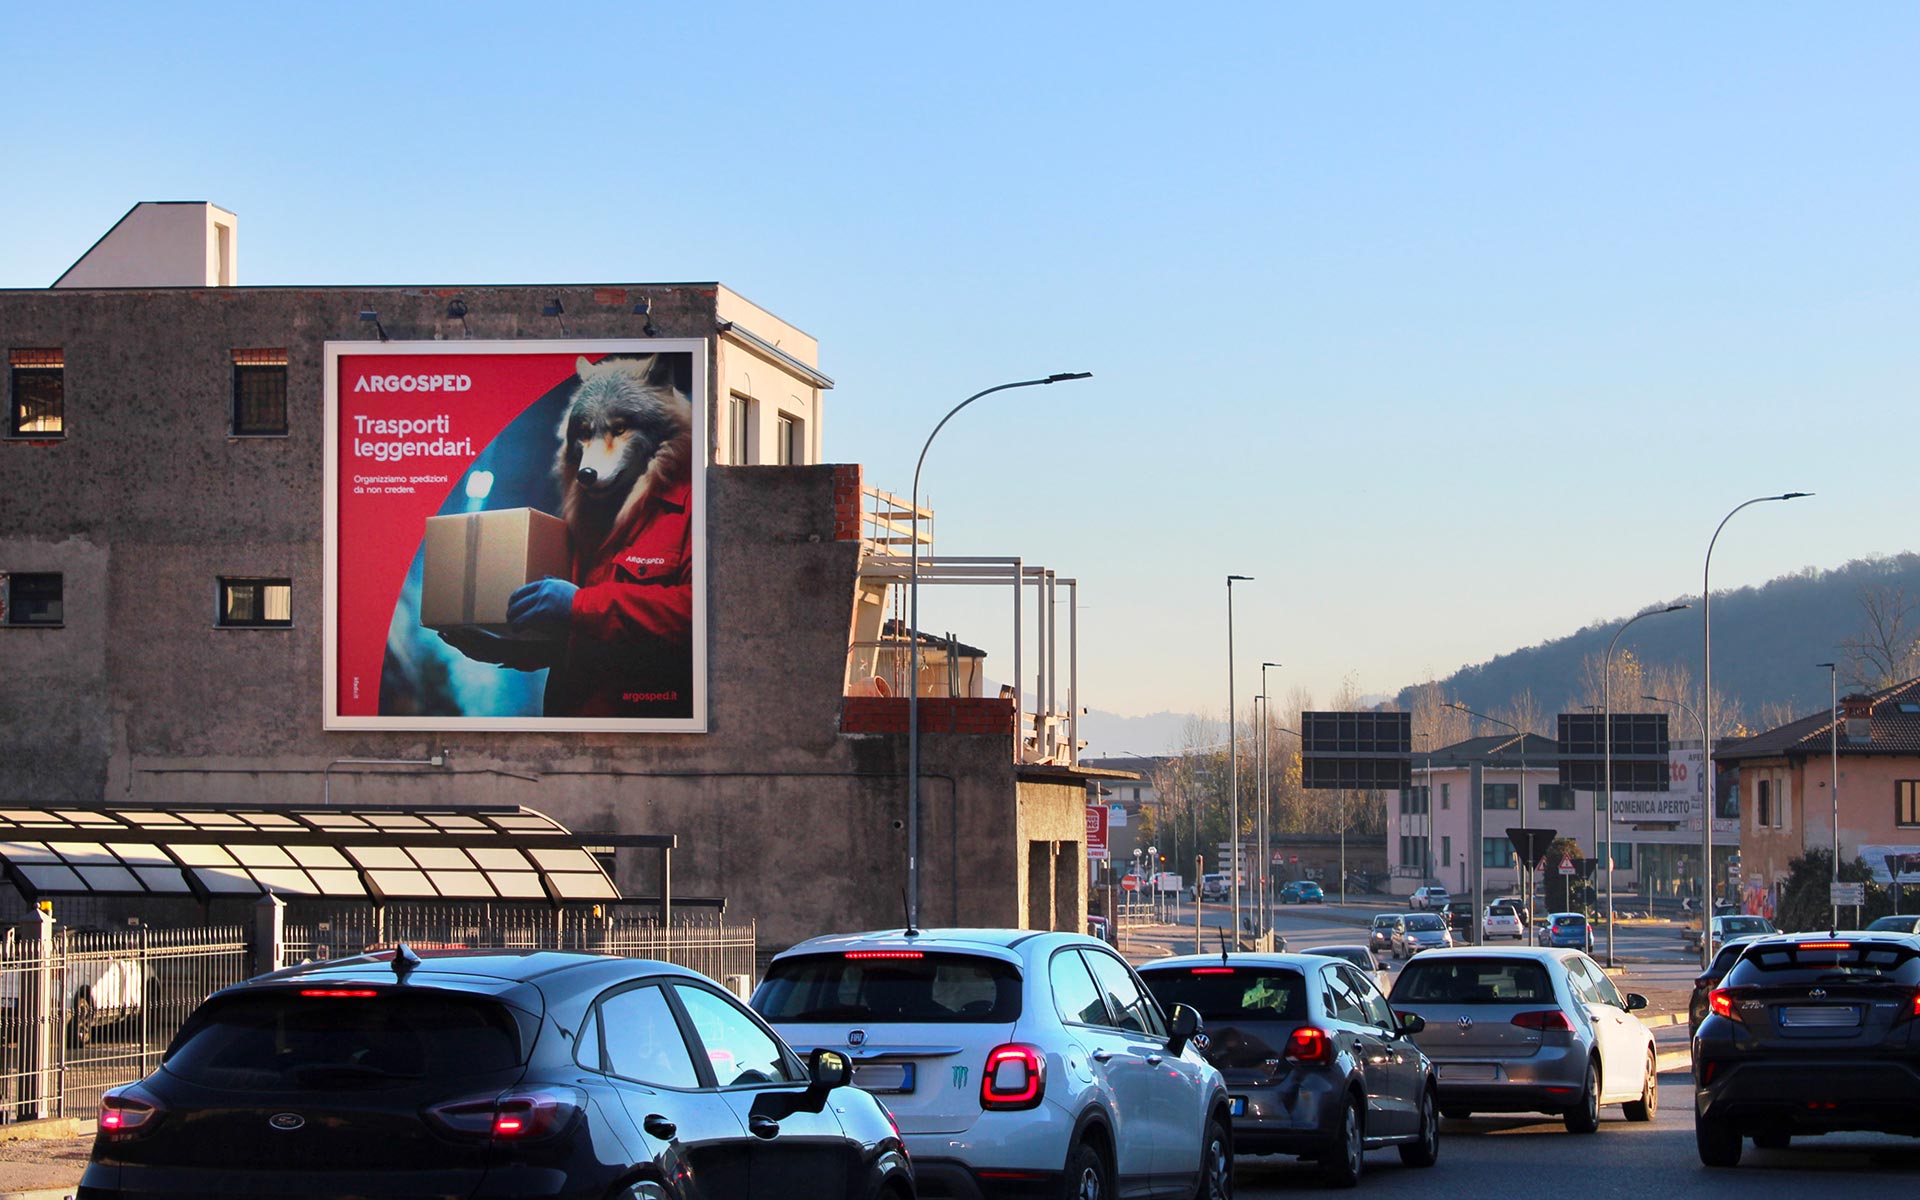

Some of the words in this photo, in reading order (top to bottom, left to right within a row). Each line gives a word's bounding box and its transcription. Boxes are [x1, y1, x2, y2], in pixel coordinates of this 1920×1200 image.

[354, 375, 472, 392] ARGOSPED
[354, 414, 450, 438] Trasporti
[354, 437, 476, 461] leggendari.
[354, 475, 407, 485] Organizziamo
[410, 475, 448, 484] spedizioni
[354, 486, 364, 494] da
[384, 486, 416, 494] credere.
[625, 556, 665, 565] ARGOSPED
[623, 691, 678, 703] argosped.it
[1613, 800, 1655, 814] DOMENICA
[1657, 800, 1690, 814] APERTO
